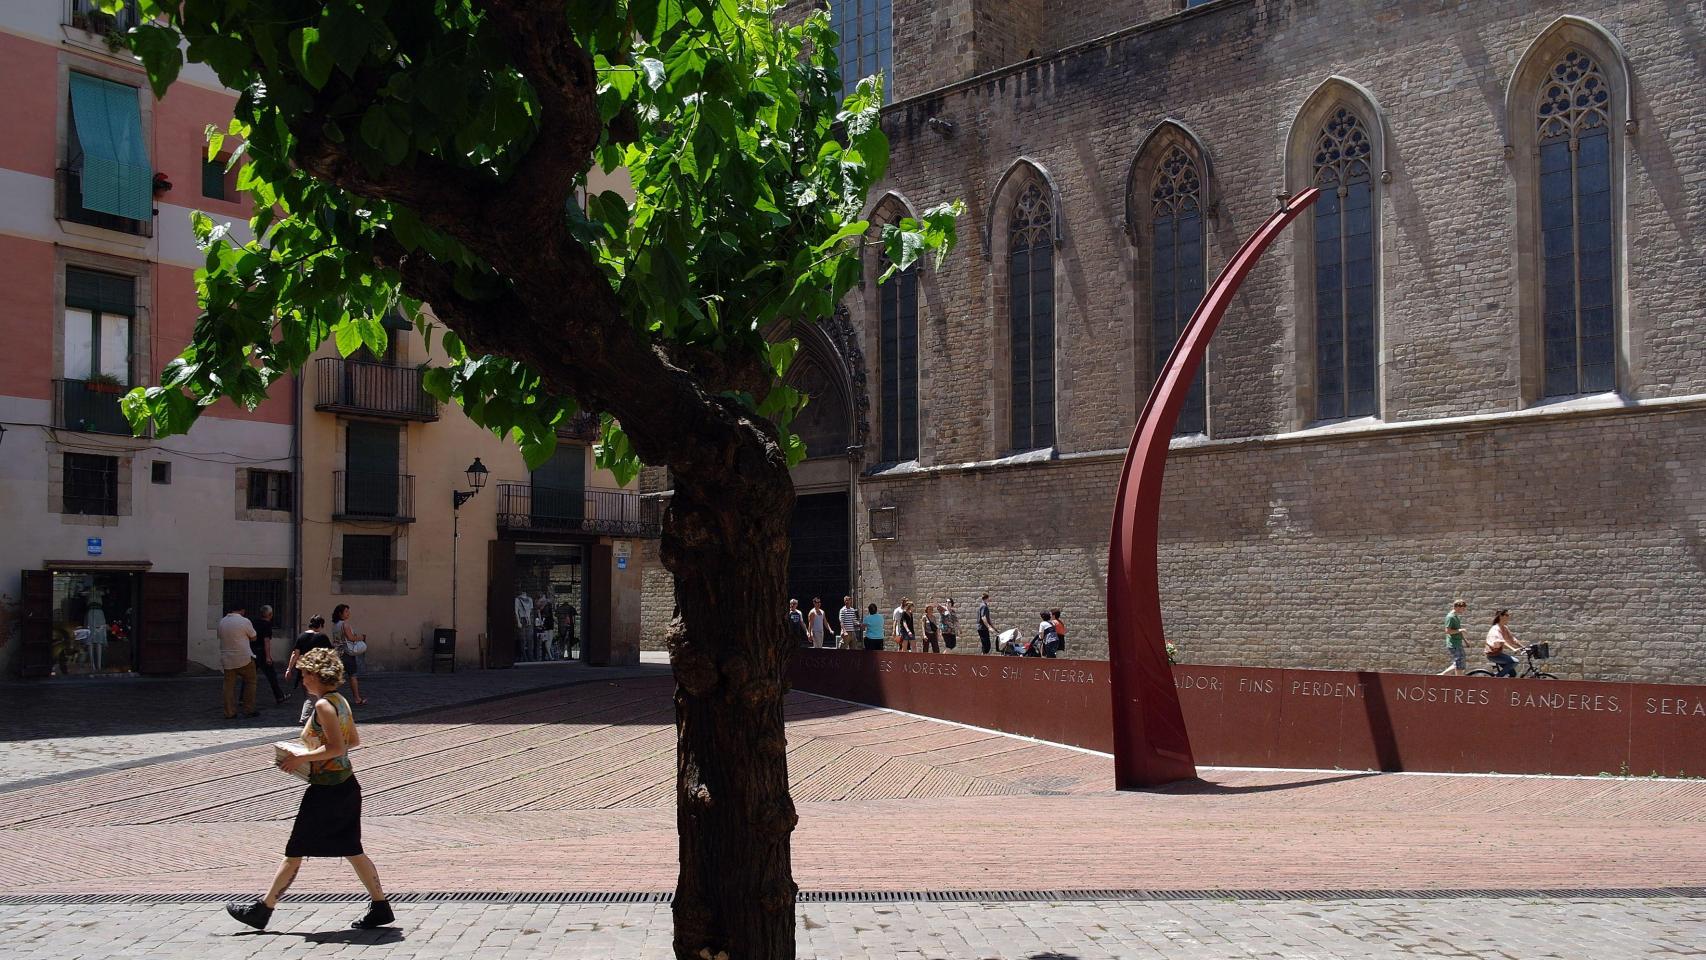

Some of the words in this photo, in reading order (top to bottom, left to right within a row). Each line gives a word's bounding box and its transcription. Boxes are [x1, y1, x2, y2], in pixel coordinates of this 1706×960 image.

[903, 661, 958, 677] MORERES
[970, 665, 990, 678] NO
[1033, 668, 1094, 685] ENTERRA
[1239, 677, 1273, 694] FINS
[1292, 681, 1366, 699] PERDENT
[1396, 686, 1489, 705] NOSTRES
